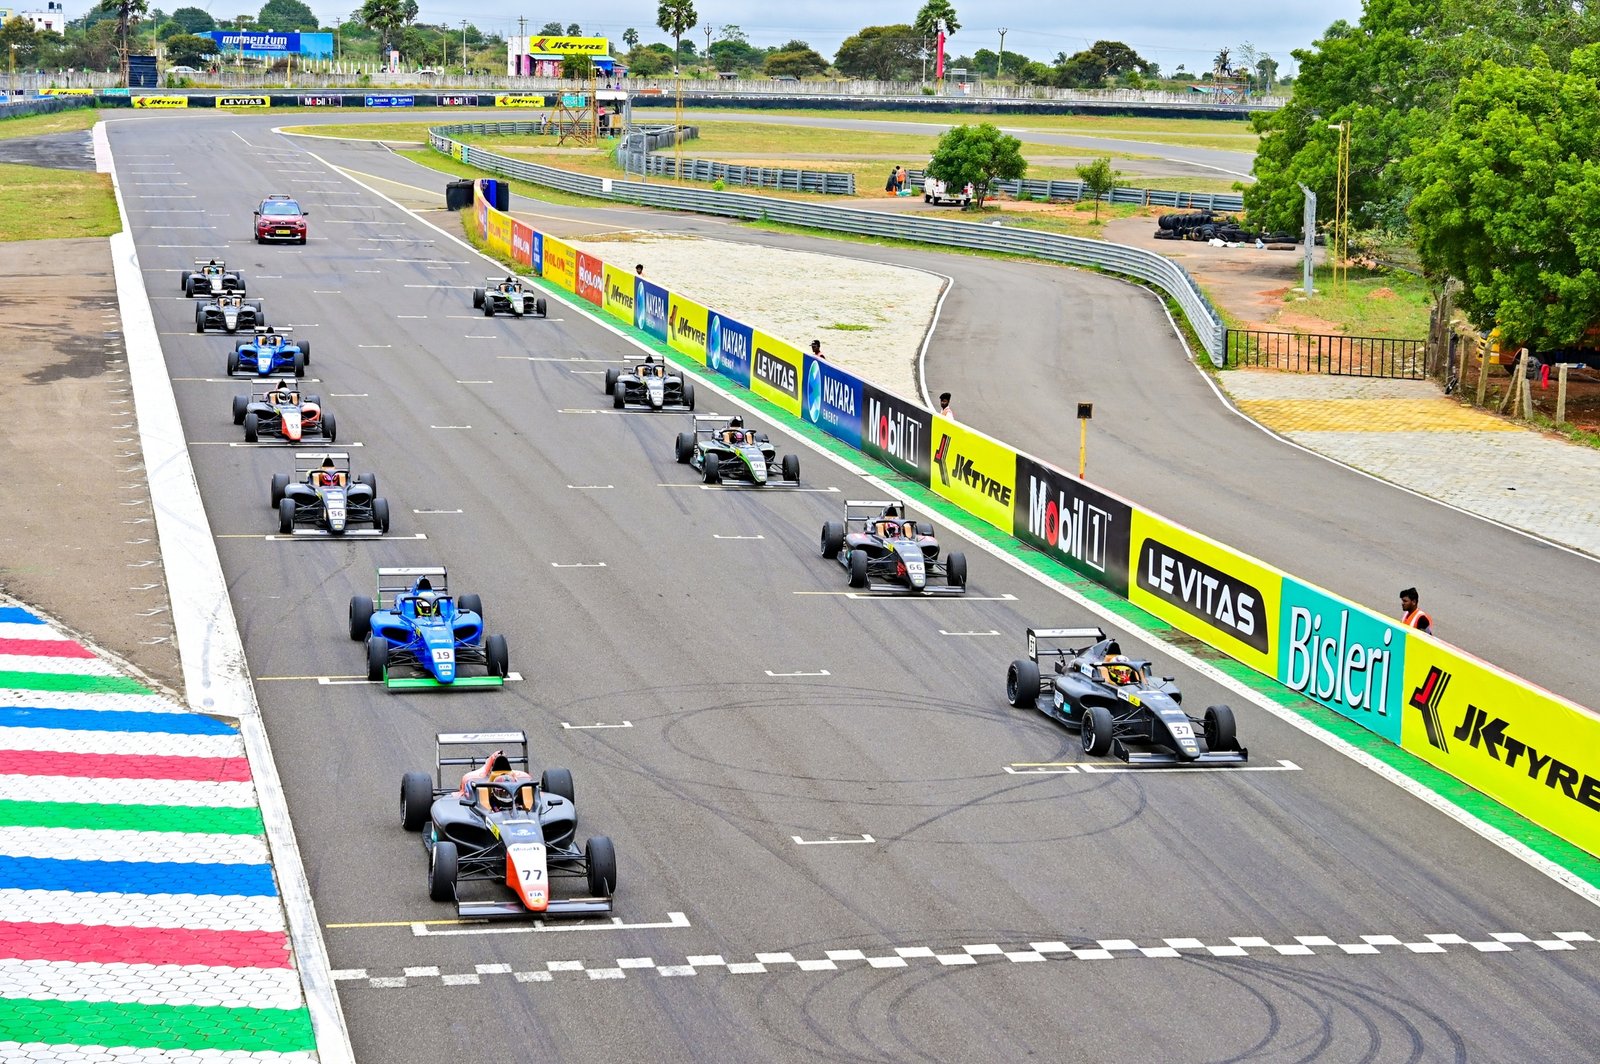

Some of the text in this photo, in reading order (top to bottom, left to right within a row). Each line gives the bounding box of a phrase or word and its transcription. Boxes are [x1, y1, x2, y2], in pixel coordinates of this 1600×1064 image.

[222, 35, 288, 46] momentum
[645, 292, 665, 321] NAYARA
[722, 327, 747, 361] NAYARA
[757, 352, 795, 393] LEVITAS
[823, 375, 856, 417] NAYARA
[868, 397, 904, 460] Mobil
[1029, 475, 1084, 561] Mobil
[909, 563, 923, 571] 66
[1147, 548, 1256, 637] LEVITAS
[436, 651, 451, 660] 19
[1286, 605, 1393, 715] Bisleri
[1173, 726, 1190, 735] 37
[522, 869, 543, 881] 77
